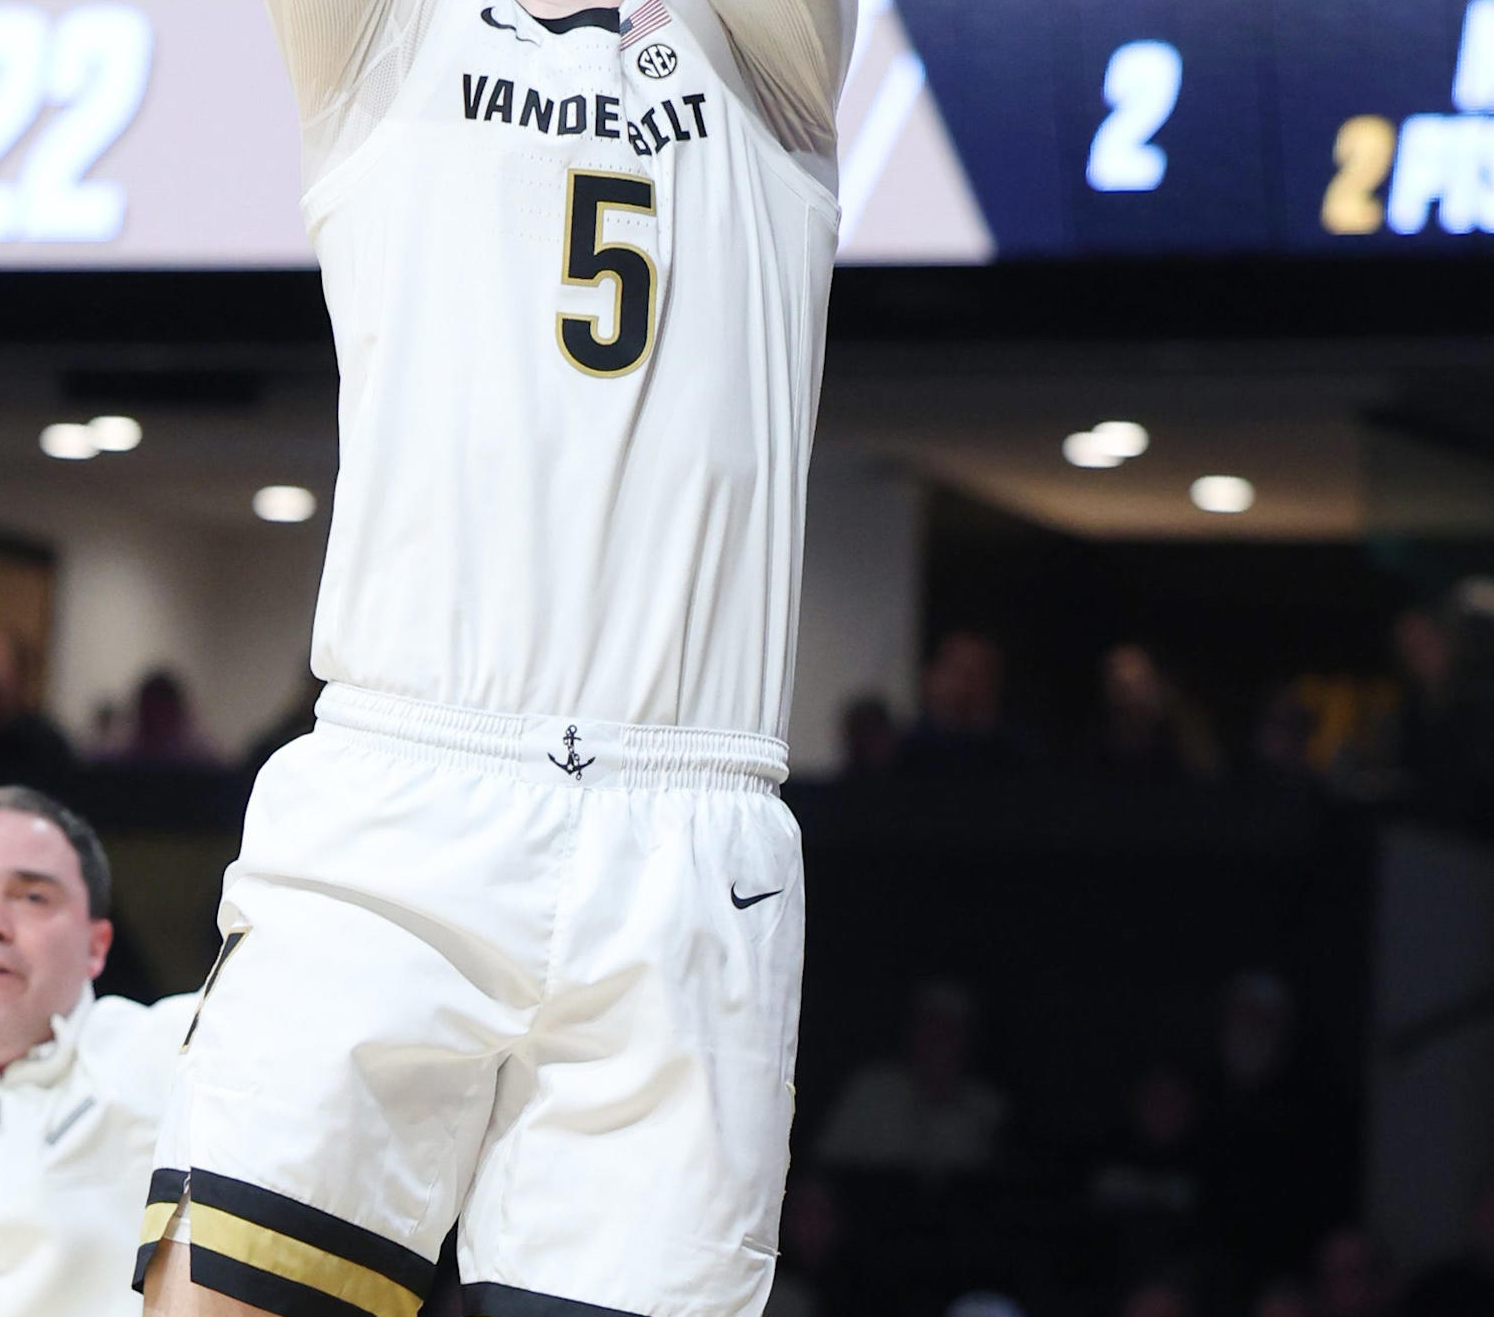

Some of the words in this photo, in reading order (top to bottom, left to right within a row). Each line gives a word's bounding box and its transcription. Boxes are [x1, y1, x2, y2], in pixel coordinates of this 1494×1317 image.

[462, 72, 709, 157] VANDEBILT
[638, 45, 678, 79] SEC
[1086, 39, 1183, 192] 2
[555, 168, 658, 379] 5
